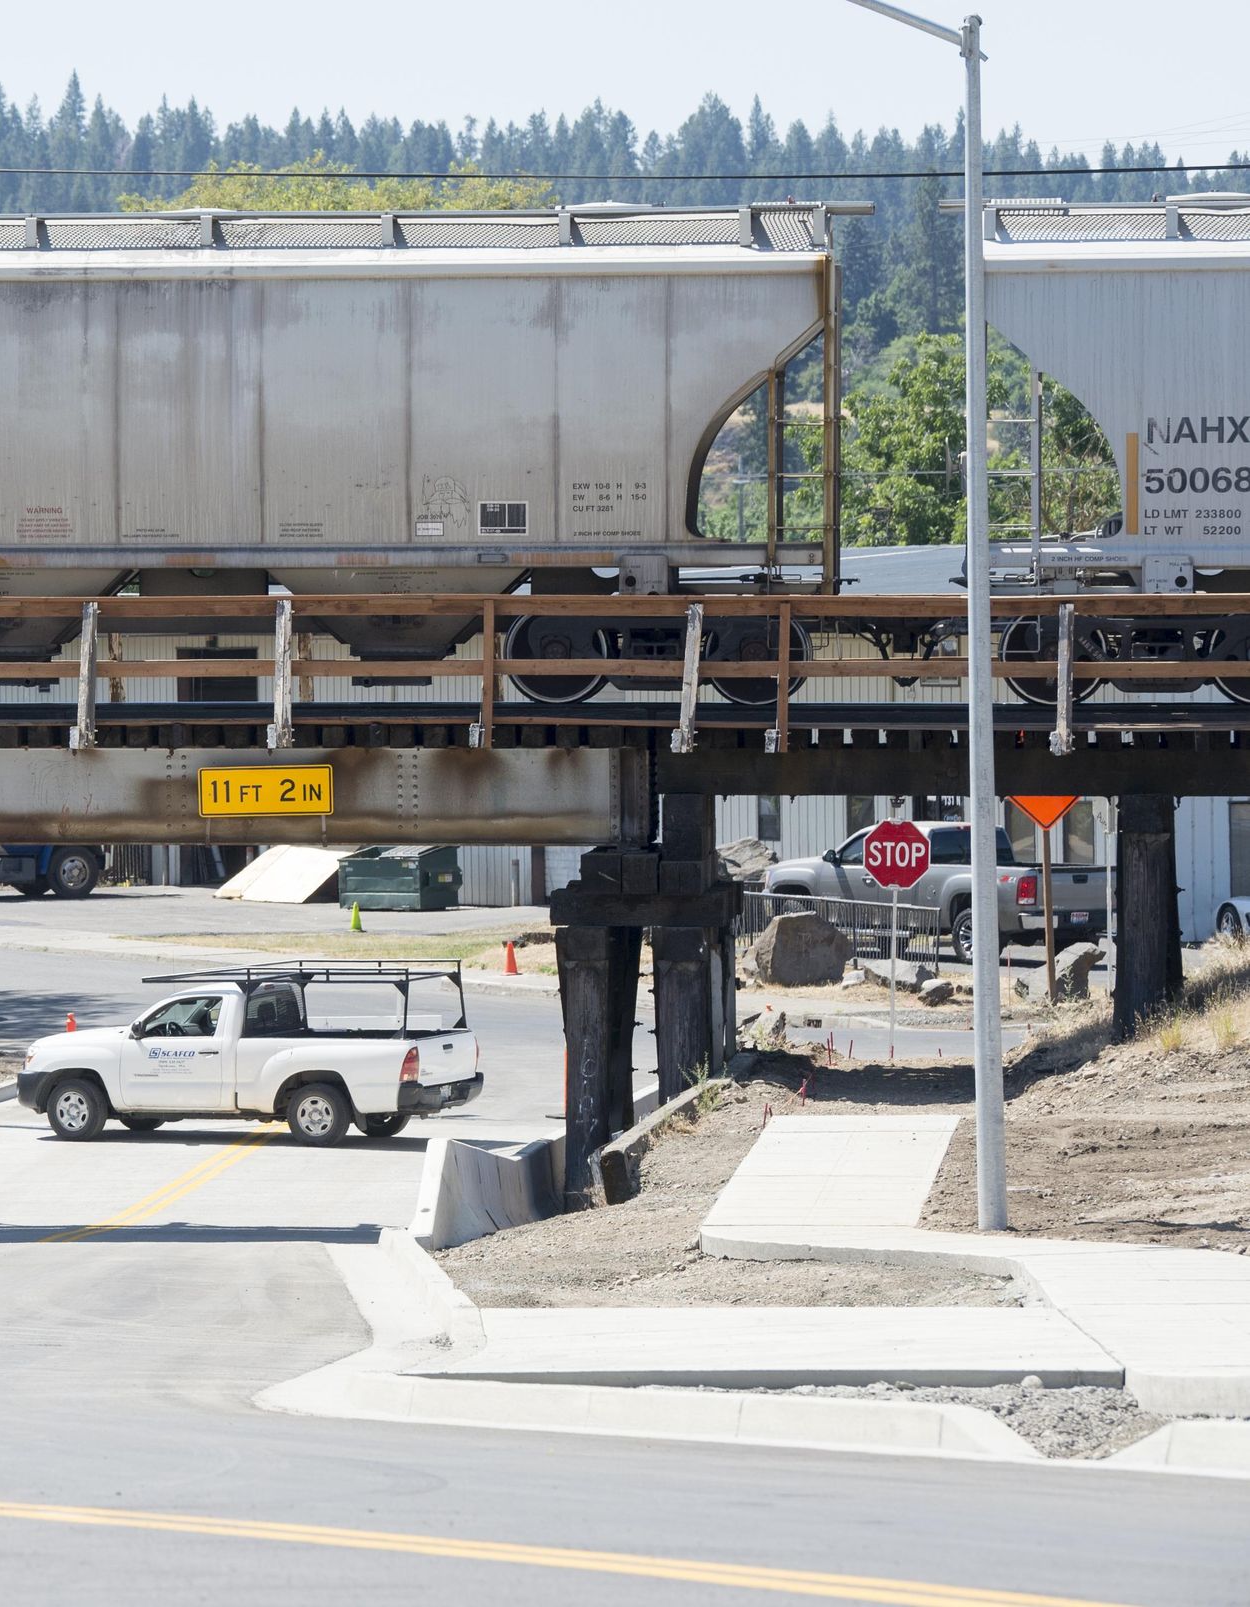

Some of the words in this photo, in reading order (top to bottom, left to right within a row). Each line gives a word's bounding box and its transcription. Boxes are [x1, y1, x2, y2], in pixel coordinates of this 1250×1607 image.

[1147, 416, 1250, 444] NAHX
[616, 482, 623, 490] H
[1144, 466, 1250, 494] 50068
[1144, 509, 1160, 519] LD
[1163, 509, 1189, 519] LMT
[1195, 509, 1242, 519] 233800
[1144, 526, 1157, 535] LT
[1164, 526, 1183, 535] WT
[1203, 526, 1242, 535] 52200
[210, 780, 230, 803] 11
[239, 785, 262, 802] FT
[279, 778, 296, 802] 2
[303, 784, 322, 801] IN
[868, 841, 926, 867] STOP
